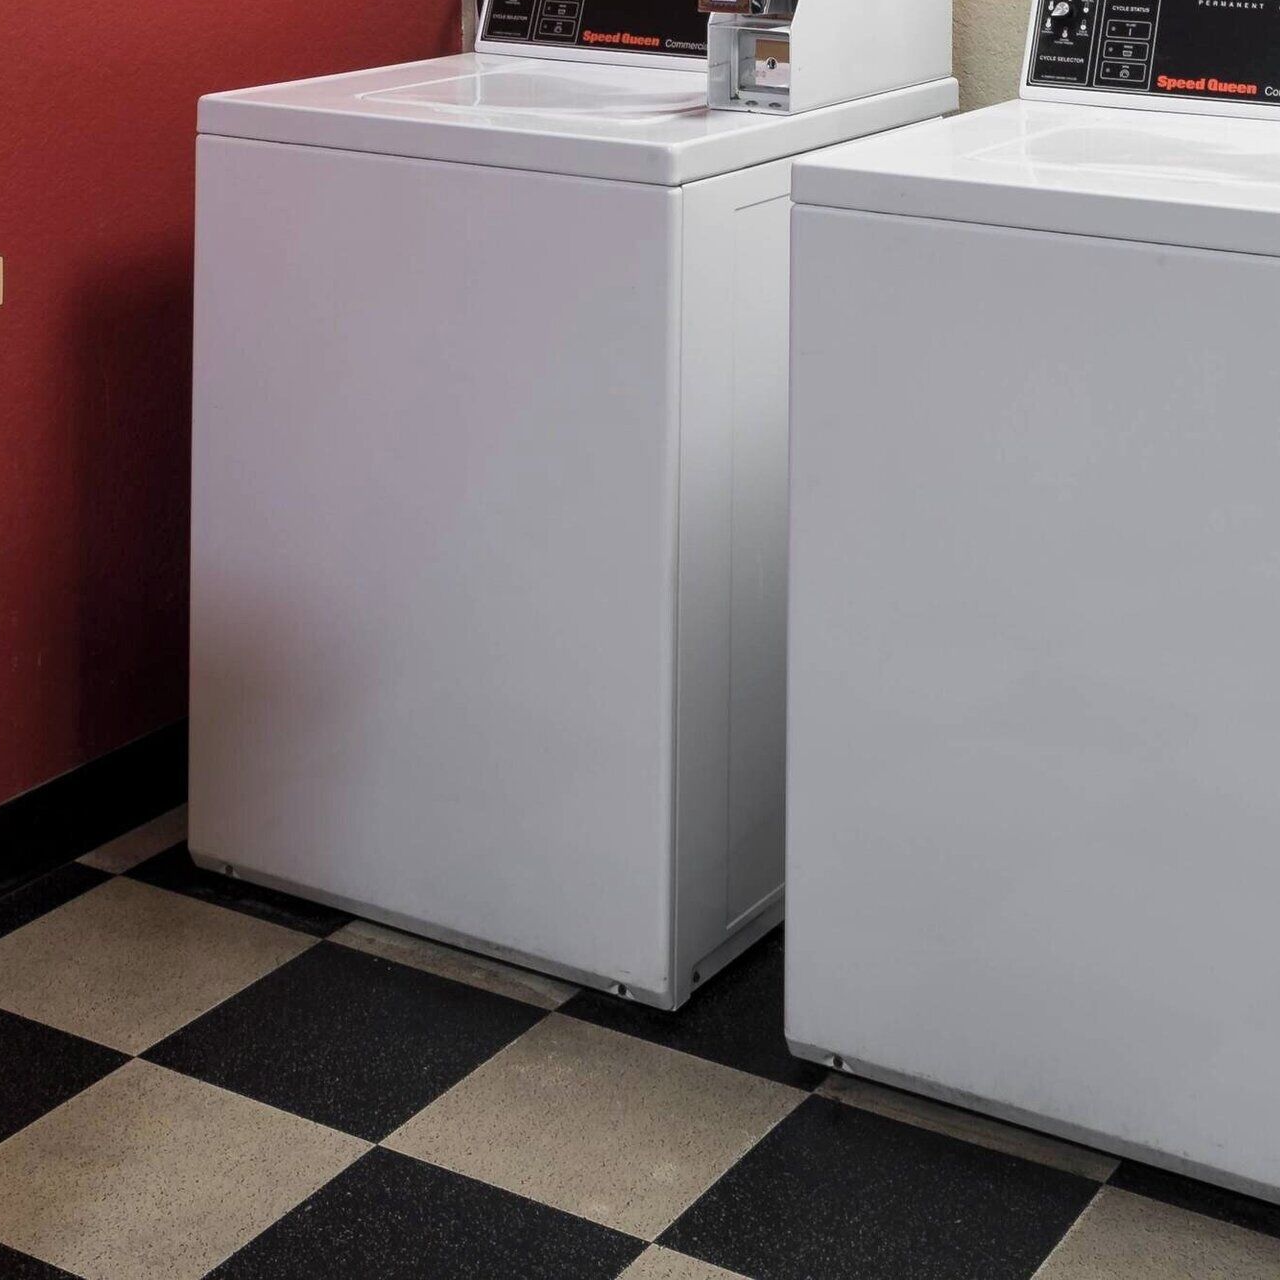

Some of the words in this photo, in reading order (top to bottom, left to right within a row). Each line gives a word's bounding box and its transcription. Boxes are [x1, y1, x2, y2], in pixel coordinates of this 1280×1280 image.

[1111, 5, 1130, 13] CYCLE
[582, 30, 621, 44] Speed
[621, 32, 661, 47] Queen
[1039, 55, 1057, 63] CYCLE
[1157, 74, 1206, 92] Speed
[1207, 78, 1258, 96] Queen
